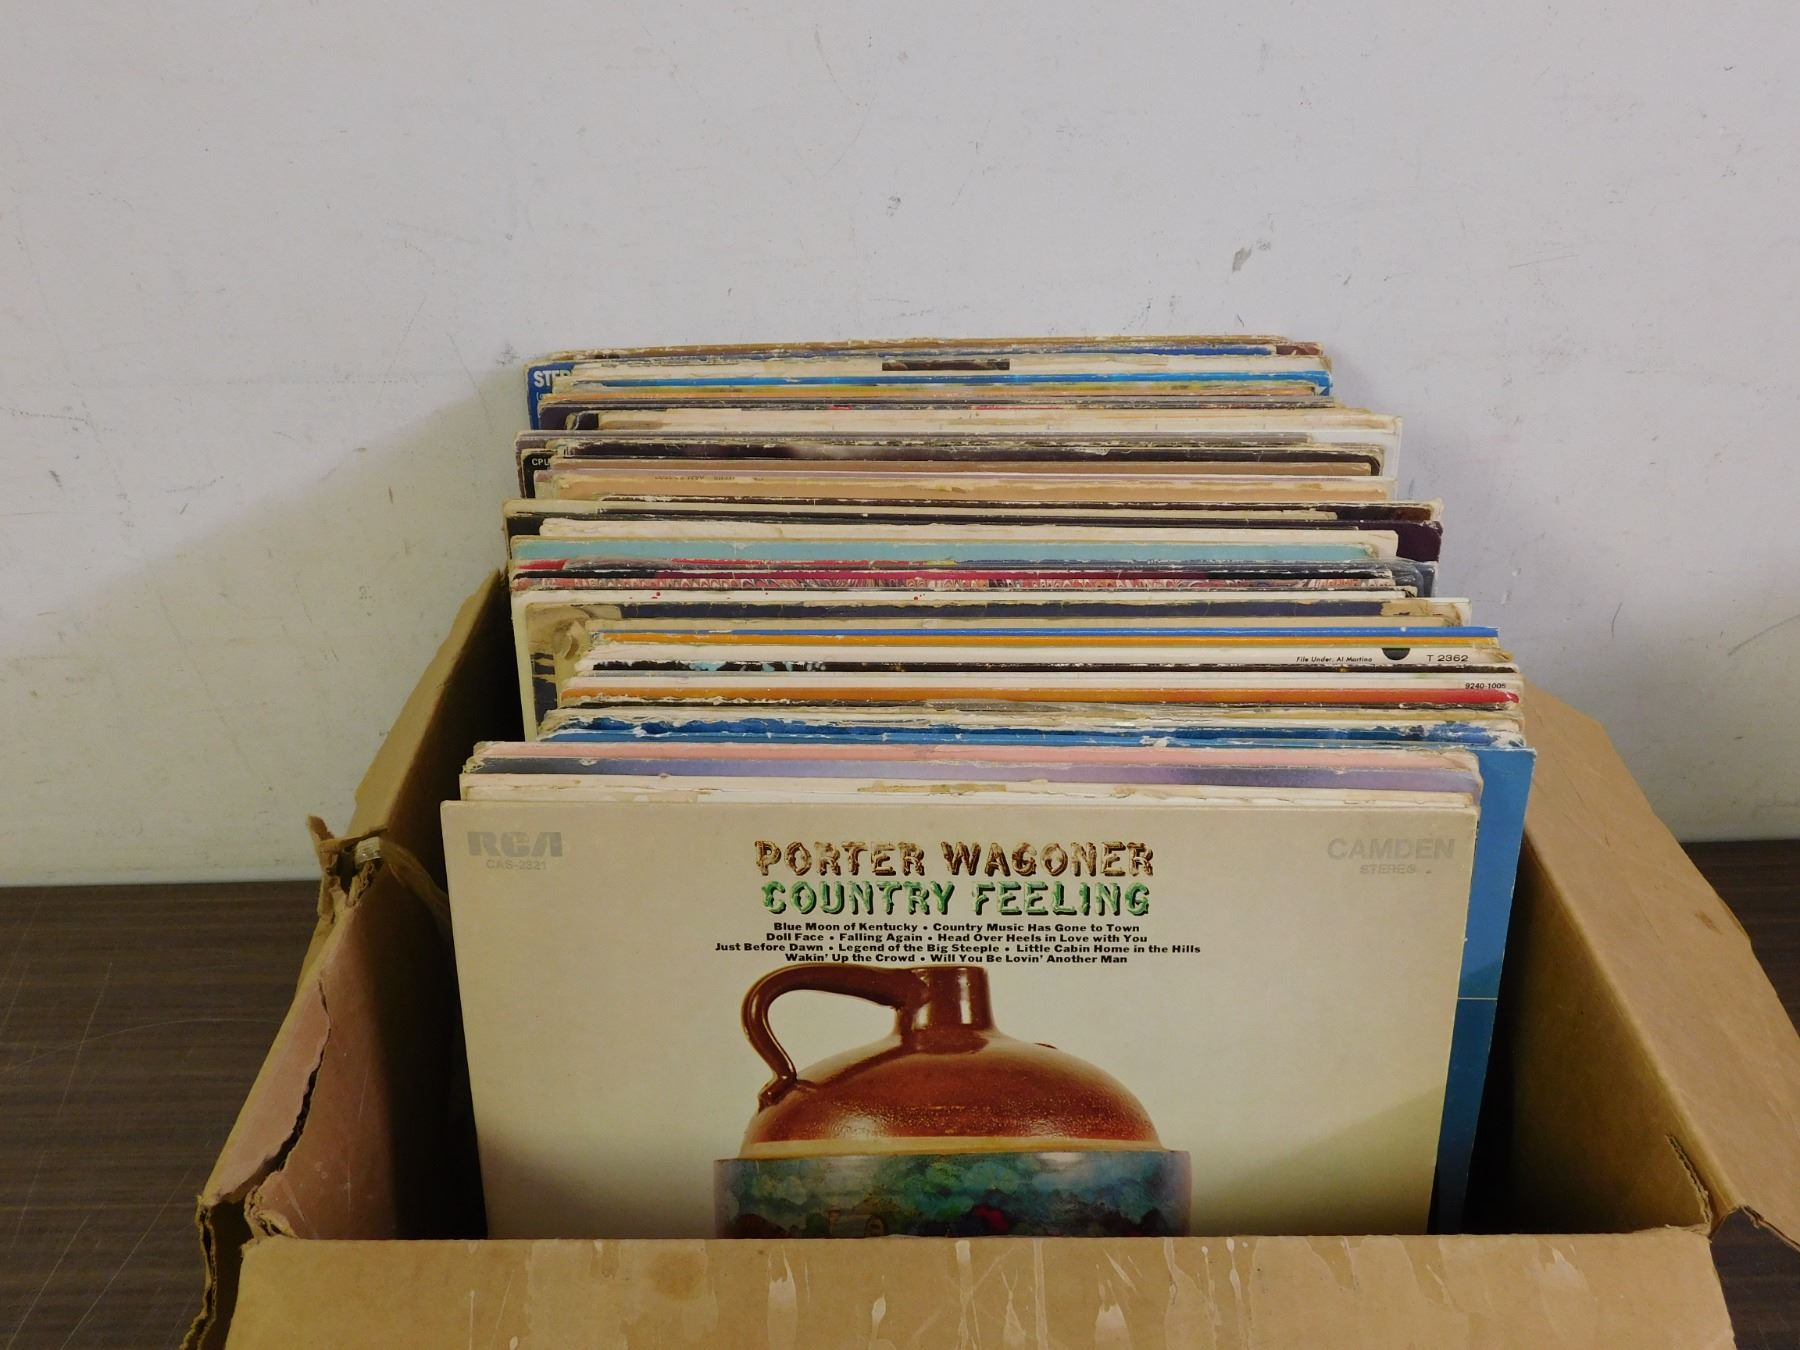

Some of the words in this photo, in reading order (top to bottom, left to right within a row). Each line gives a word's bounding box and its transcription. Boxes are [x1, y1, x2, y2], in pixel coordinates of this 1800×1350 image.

[467, 832, 563, 857] RCA
[1327, 838, 1455, 861] CAMDEN
[754, 841, 926, 876] PORTER
[940, 841, 1154, 876] WAGONER
[762, 881, 955, 915] COUNTRY
[971, 881, 1150, 916] FEELING
[774, 922, 801, 932] Blue
[805, 923, 840, 932] Moon
[843, 922, 857, 932] of
[858, 922, 918, 935] Kentucky
[933, 923, 983, 935] Country
[986, 923, 1024, 933] Music
[1027, 923, 1052, 933] Has
[1054, 924, 1087, 933] Gone
[1090, 924, 1103, 933] to
[1106, 924, 1140, 934] Town
[766, 932, 792, 942] Doll
[795, 932, 824, 942] Face
[839, 932, 883, 945] Falling
[886, 933, 923, 945] Again
[937, 933, 970, 943] Head
[973, 933, 1004, 943] Over
[1006, 933, 1042, 943] Heels
[1044, 933, 1057, 943] in
[1060, 934, 1089, 943] Love
[1092, 934, 1120, 943] with
[1123, 934, 1148, 943] You
[715, 942, 741, 952] Just
[744, 942, 786, 952] Before
[788, 942, 824, 952] Dawn
[838, 942, 885, 955] Legend
[888, 943, 901, 953] of
[902, 943, 924, 953] the
[926, 943, 949, 956] Big
[951, 943, 1000, 956] Steeple
[1016, 943, 1051, 953] Little
[1053, 944, 1090, 954] Cabin
[1093, 944, 1130, 954] Home
[1133, 944, 1145, 954] in
[1148, 944, 1169, 954] the
[1172, 944, 1201, 955] Hills
[785, 952, 829, 962] Wakin'
[831, 953, 849, 965] Up
[851, 952, 872, 962] the
[875, 953, 916, 963] Crowd
[930, 953, 956, 963] Will
[958, 953, 983, 963] You
[986, 954, 1003, 963] Be
[1005, 953, 1044, 964] Lovin'
[1046, 954, 1098, 964] Another
[1101, 954, 1128, 964] Man
